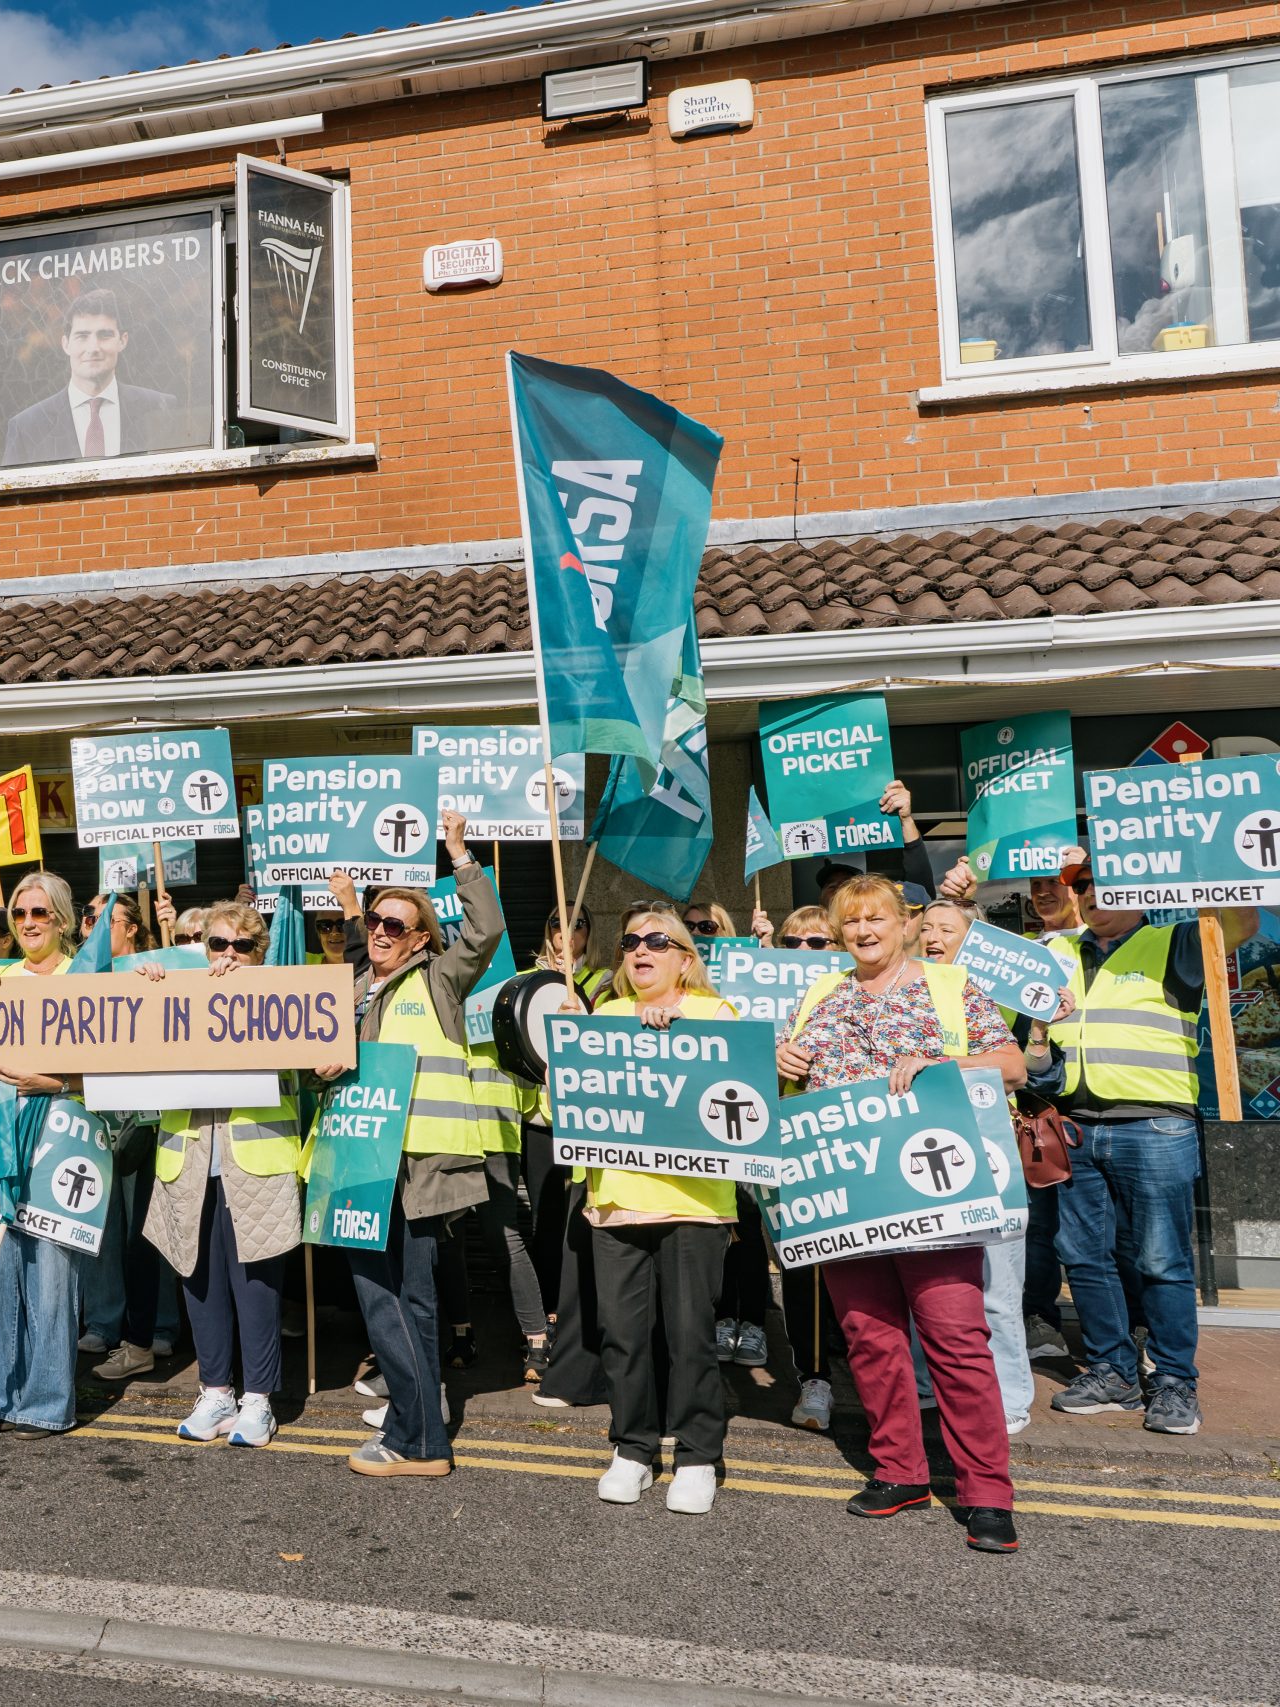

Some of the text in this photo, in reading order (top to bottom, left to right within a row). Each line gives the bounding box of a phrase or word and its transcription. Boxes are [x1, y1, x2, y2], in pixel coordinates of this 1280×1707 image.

[683, 96, 717, 107] Sharp
[684, 102, 732, 116] Security
[258, 210, 325, 238] FIANNA FÁIL
[38, 240, 164, 280] CHAMBERS
[172, 236, 200, 262] TD
[437, 246, 489, 261] DIGITAL
[440, 257, 487, 270] SECURITY
[261, 358, 327, 381] CONSTITUENCY
[280, 373, 310, 388] OFFICE
[76, 735, 201, 769] Pension
[768, 724, 883, 754] OFFICIAL
[438, 761, 518, 791] arity
[782, 748, 872, 776] PICKET
[967, 748, 1065, 781] OFFICIAL
[80, 767, 174, 801] parity
[267, 761, 401, 793] Pension
[975, 771, 1053, 800] PICKET
[1091, 766, 1261, 808] Pension
[83, 797, 145, 823] now
[268, 793, 367, 831] parity
[438, 794, 484, 813] ow
[83, 822, 236, 844] OFFICIAL PICKET FÓRSA
[488, 825, 545, 837] PICKET
[835, 817, 895, 848] FÓRSA
[1094, 805, 1222, 849] parity
[268, 833, 329, 856] now
[146, 859, 192, 884] FRSA
[271, 867, 330, 881] OFFICIAL
[404, 867, 431, 882] FÓRSA
[1097, 850, 1182, 877] now
[1102, 885, 1265, 906] OFFICIAL PICKET
[965, 930, 1051, 977] Pension
[956, 950, 1026, 987] parity
[41, 995, 144, 1045] PARITY
[163, 996, 190, 1043] IN
[207, 991, 339, 1043] SCHOOLS
[394, 1001, 426, 1017] FÓRSA
[551, 1021, 729, 1062] Pension
[323, 1085, 402, 1112] OFFICIAL
[554, 1060, 687, 1108] parity
[322, 1114, 388, 1139] PICKET
[556, 1104, 646, 1135] now
[780, 1091, 920, 1145] ension
[559, 1144, 776, 1180] OFFICIAL PICKET FÓRSA
[780, 1137, 881, 1186] arity
[16, 1209, 62, 1235] CKET
[333, 1200, 380, 1241] FÓRSA
[765, 1187, 849, 1231] now
[70, 1224, 96, 1246] FÓRSA
[782, 1232, 864, 1263] OFFICIAL
[866, 1213, 945, 1245] PICKET
[960, 1204, 1000, 1226] FÓRSA
